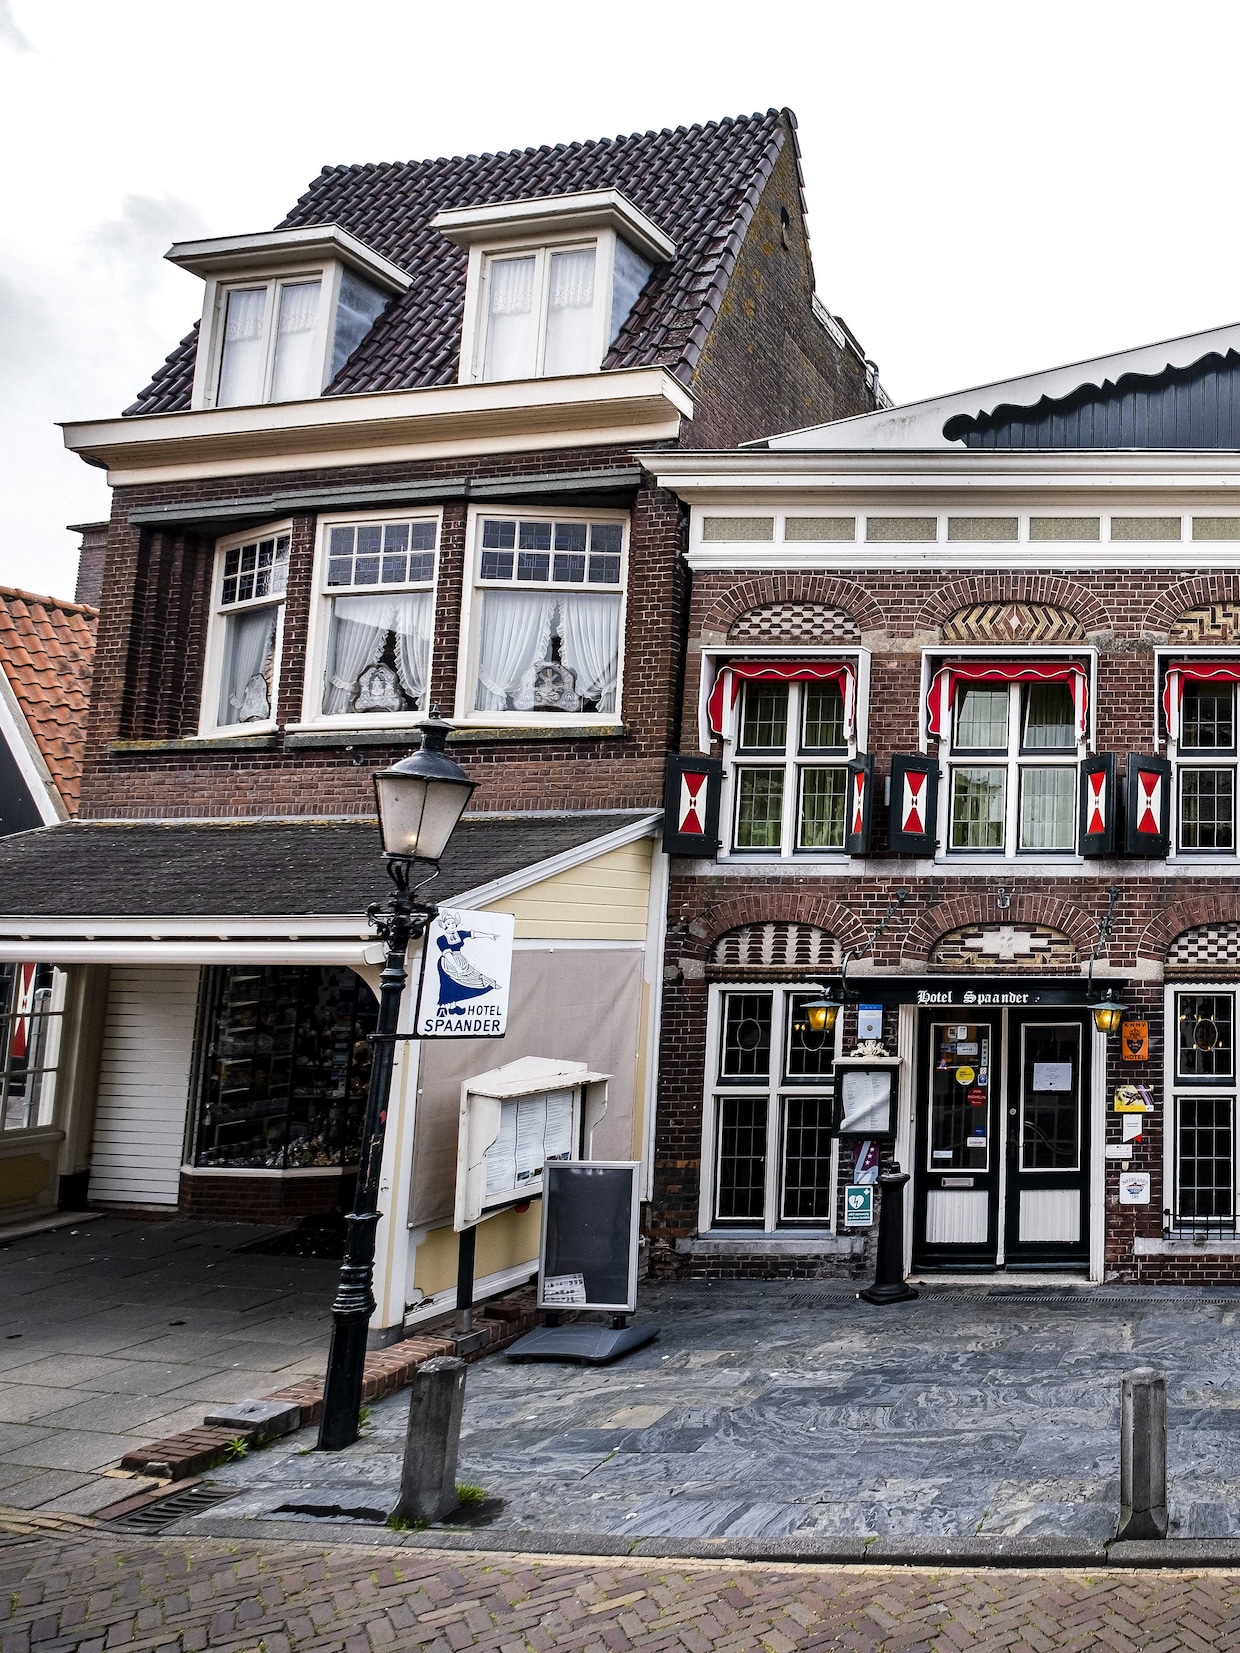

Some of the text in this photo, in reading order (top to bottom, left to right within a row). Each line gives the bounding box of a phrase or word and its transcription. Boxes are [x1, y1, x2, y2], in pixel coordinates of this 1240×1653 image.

[917, 989, 1030, 1006] Hotel Spaander
[467, 1005, 502, 1016] HOTEL
[424, 1019, 501, 1032] SPAANDER
